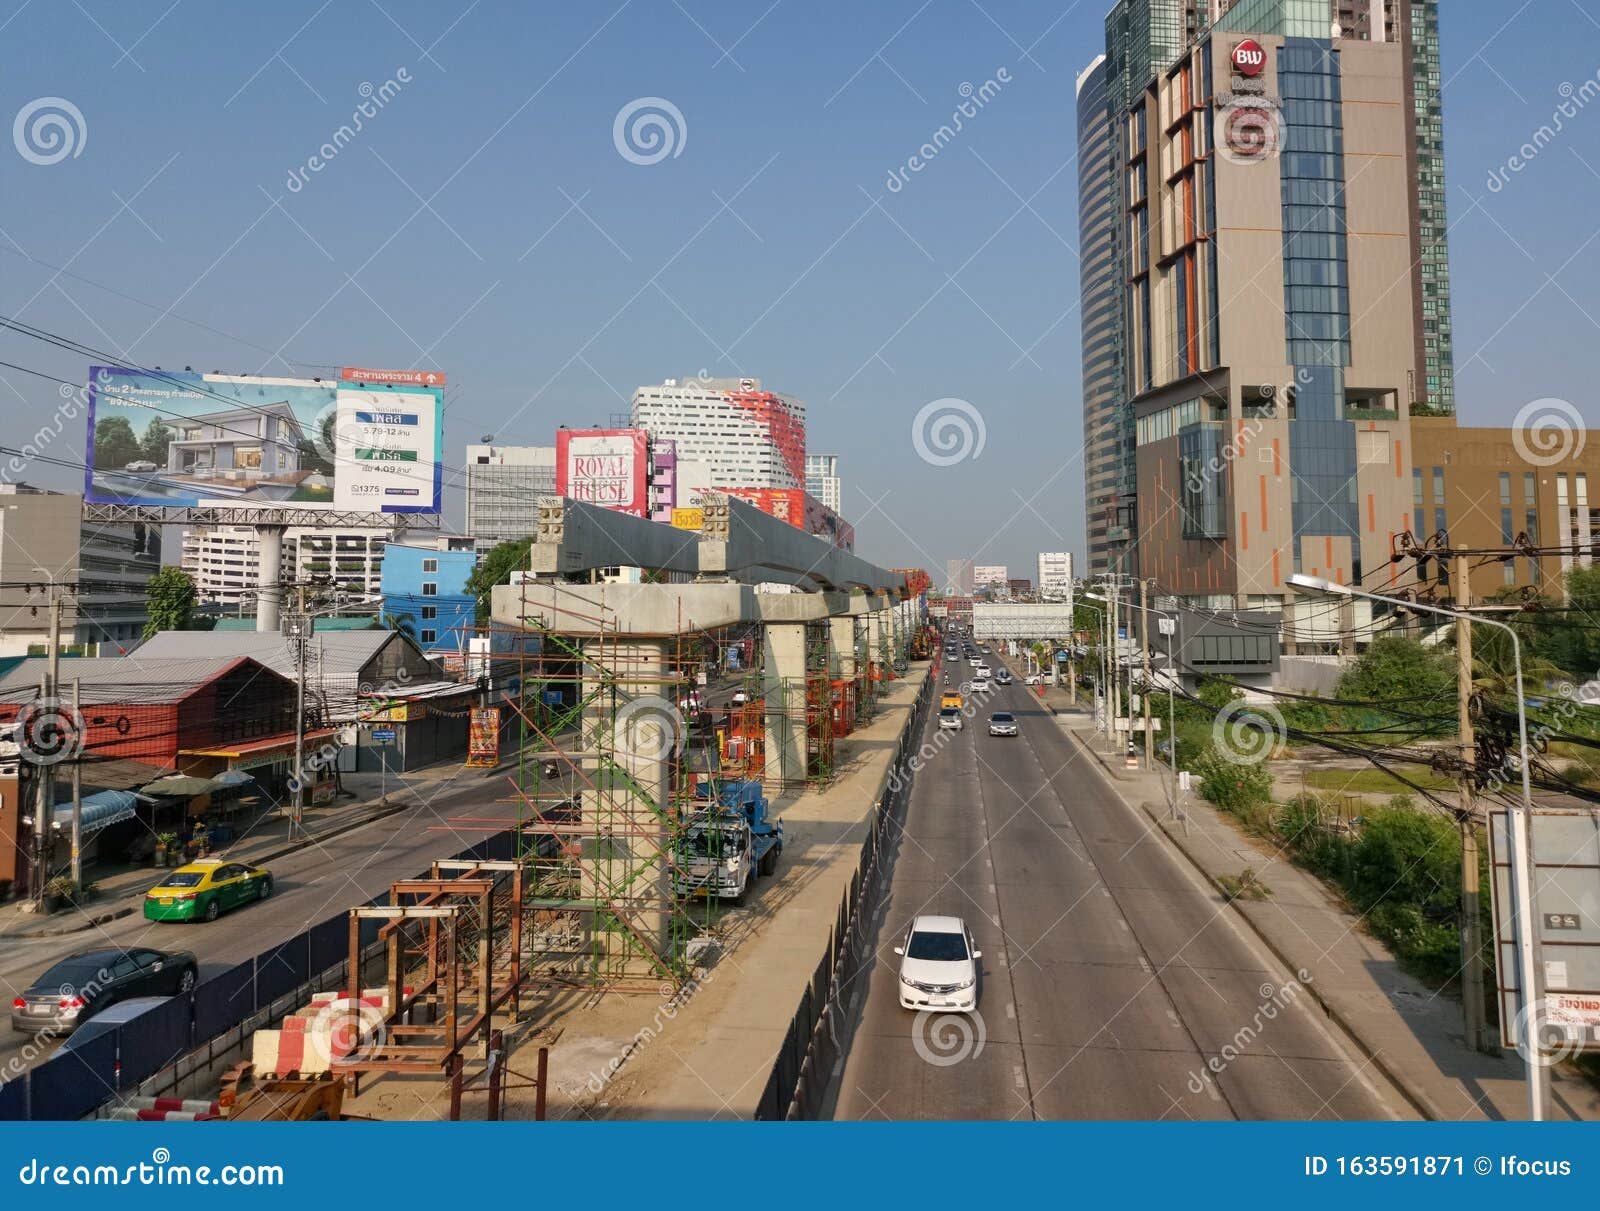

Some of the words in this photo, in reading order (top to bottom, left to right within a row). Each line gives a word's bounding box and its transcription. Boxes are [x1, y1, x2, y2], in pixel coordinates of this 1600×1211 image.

[1236, 50, 1263, 65] BW
[415, 373, 422, 382] 4
[122, 385, 129, 394] 2
[574, 457, 628, 479] ROYAL
[359, 485, 380, 493] 1375
[574, 480, 628, 500] HOUSE
